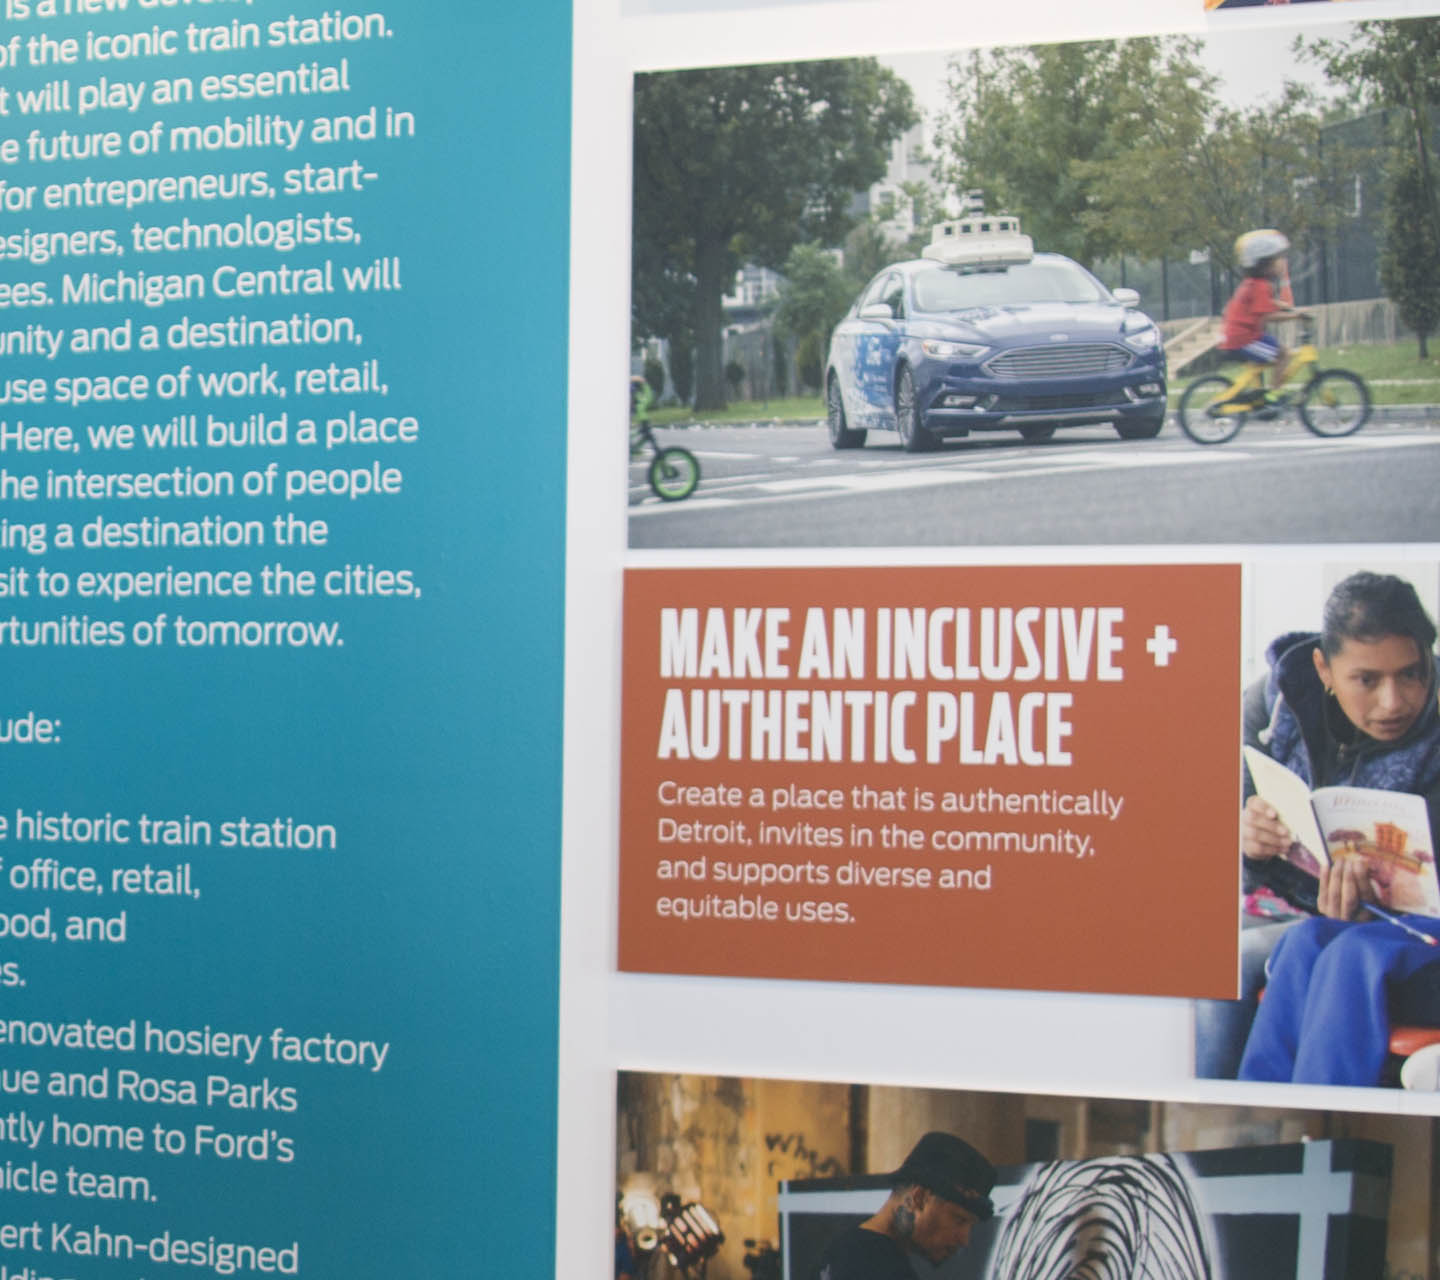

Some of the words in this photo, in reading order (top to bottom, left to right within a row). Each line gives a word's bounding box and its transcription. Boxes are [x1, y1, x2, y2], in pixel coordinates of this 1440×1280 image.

[660, 607, 791, 679] MAKE
[798, 607, 866, 680] AN
[876, 606, 1124, 682] INCLUSIVE
[657, 688, 917, 764] AUTHENTIC
[926, 691, 1073, 767] PLACE
[16, 808, 130, 843] historic
[138, 814, 212, 845] train
[220, 816, 337, 849] station
